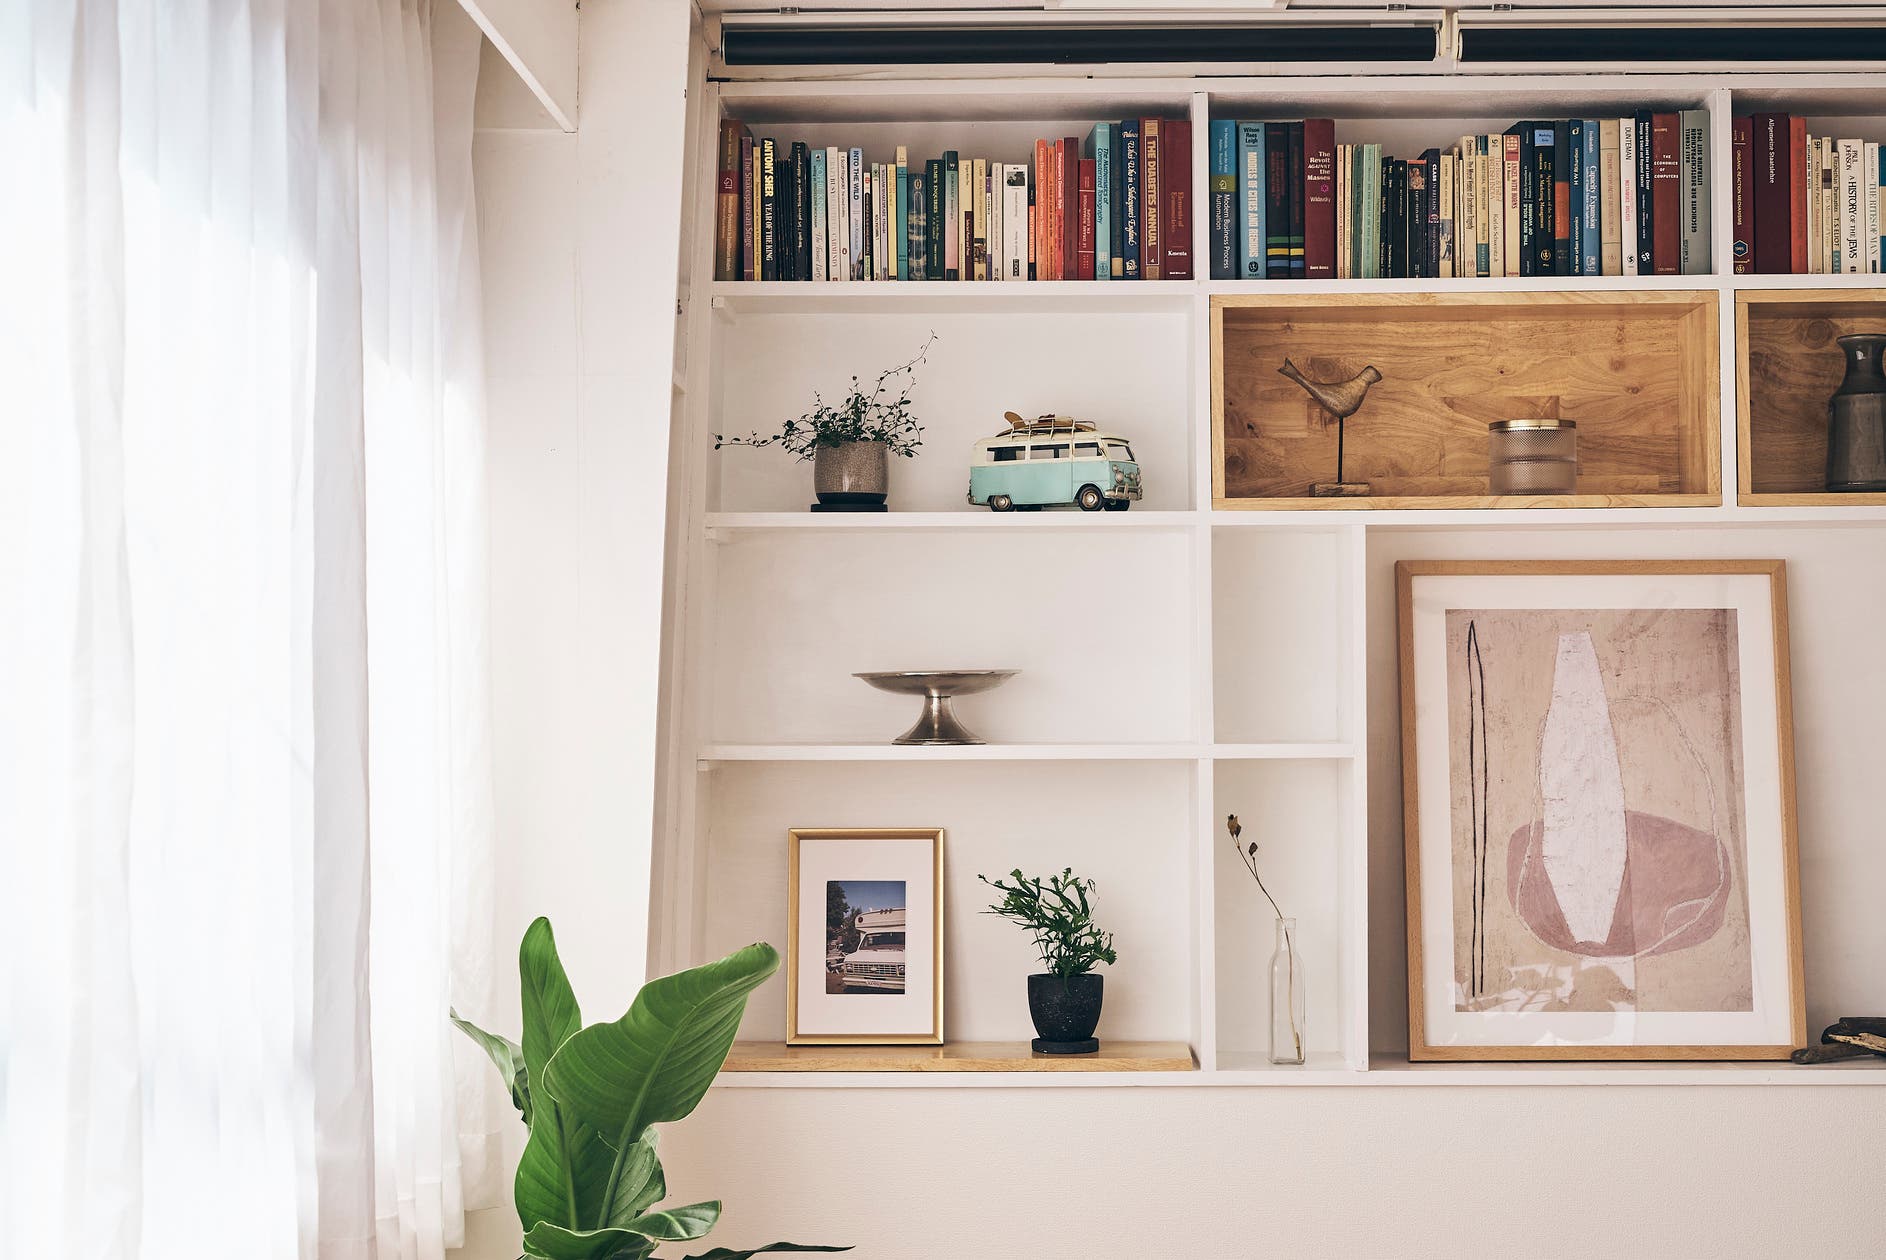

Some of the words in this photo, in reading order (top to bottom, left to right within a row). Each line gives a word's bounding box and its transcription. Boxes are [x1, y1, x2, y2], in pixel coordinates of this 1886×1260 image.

[764, 140, 774, 174] ANTONY
[1147, 140, 1157, 158] THE
[1844, 145, 1852, 170] JOHNSON
[744, 158, 752, 170] The
[1126, 160, 1136, 176] Who
[1248, 152, 1258, 178] MODELS
[1147, 161, 1157, 205] DIABETES
[1466, 169, 1474, 179] Moral
[1589, 166, 1597, 193] Capacity
[764, 175, 774, 197] SHER
[1248, 180, 1258, 188] OF
[1869, 182, 1878, 199] THE
[744, 172, 752, 226] Shakespearean
[1248, 190, 1258, 211] CITIES
[1466, 198, 1474, 214] Jacobean
[1848, 181, 1857, 215] HISTORY
[765, 203, 773, 220] YEAR
[1248, 213, 1258, 226] AND
[1589, 196, 1597, 229] Expansion
[1849, 215, 1855, 223] OF
[1869, 200, 1878, 223] RITES
[765, 221, 773, 229] OF
[1147, 207, 1157, 247] ANNUAL
[1466, 215, 1474, 230] Tragedy
[1528, 227, 1533, 235] OF
[1869, 224, 1878, 234] OF
[744, 228, 752, 248] Stage
[765, 230, 773, 244] THE
[1126, 219, 1136, 246] England
[1248, 229, 1258, 257] REGIONS
[1848, 238, 1857, 259] JEWS
[1869, 237, 1878, 255] MAN
[765, 245, 773, 261] KING
